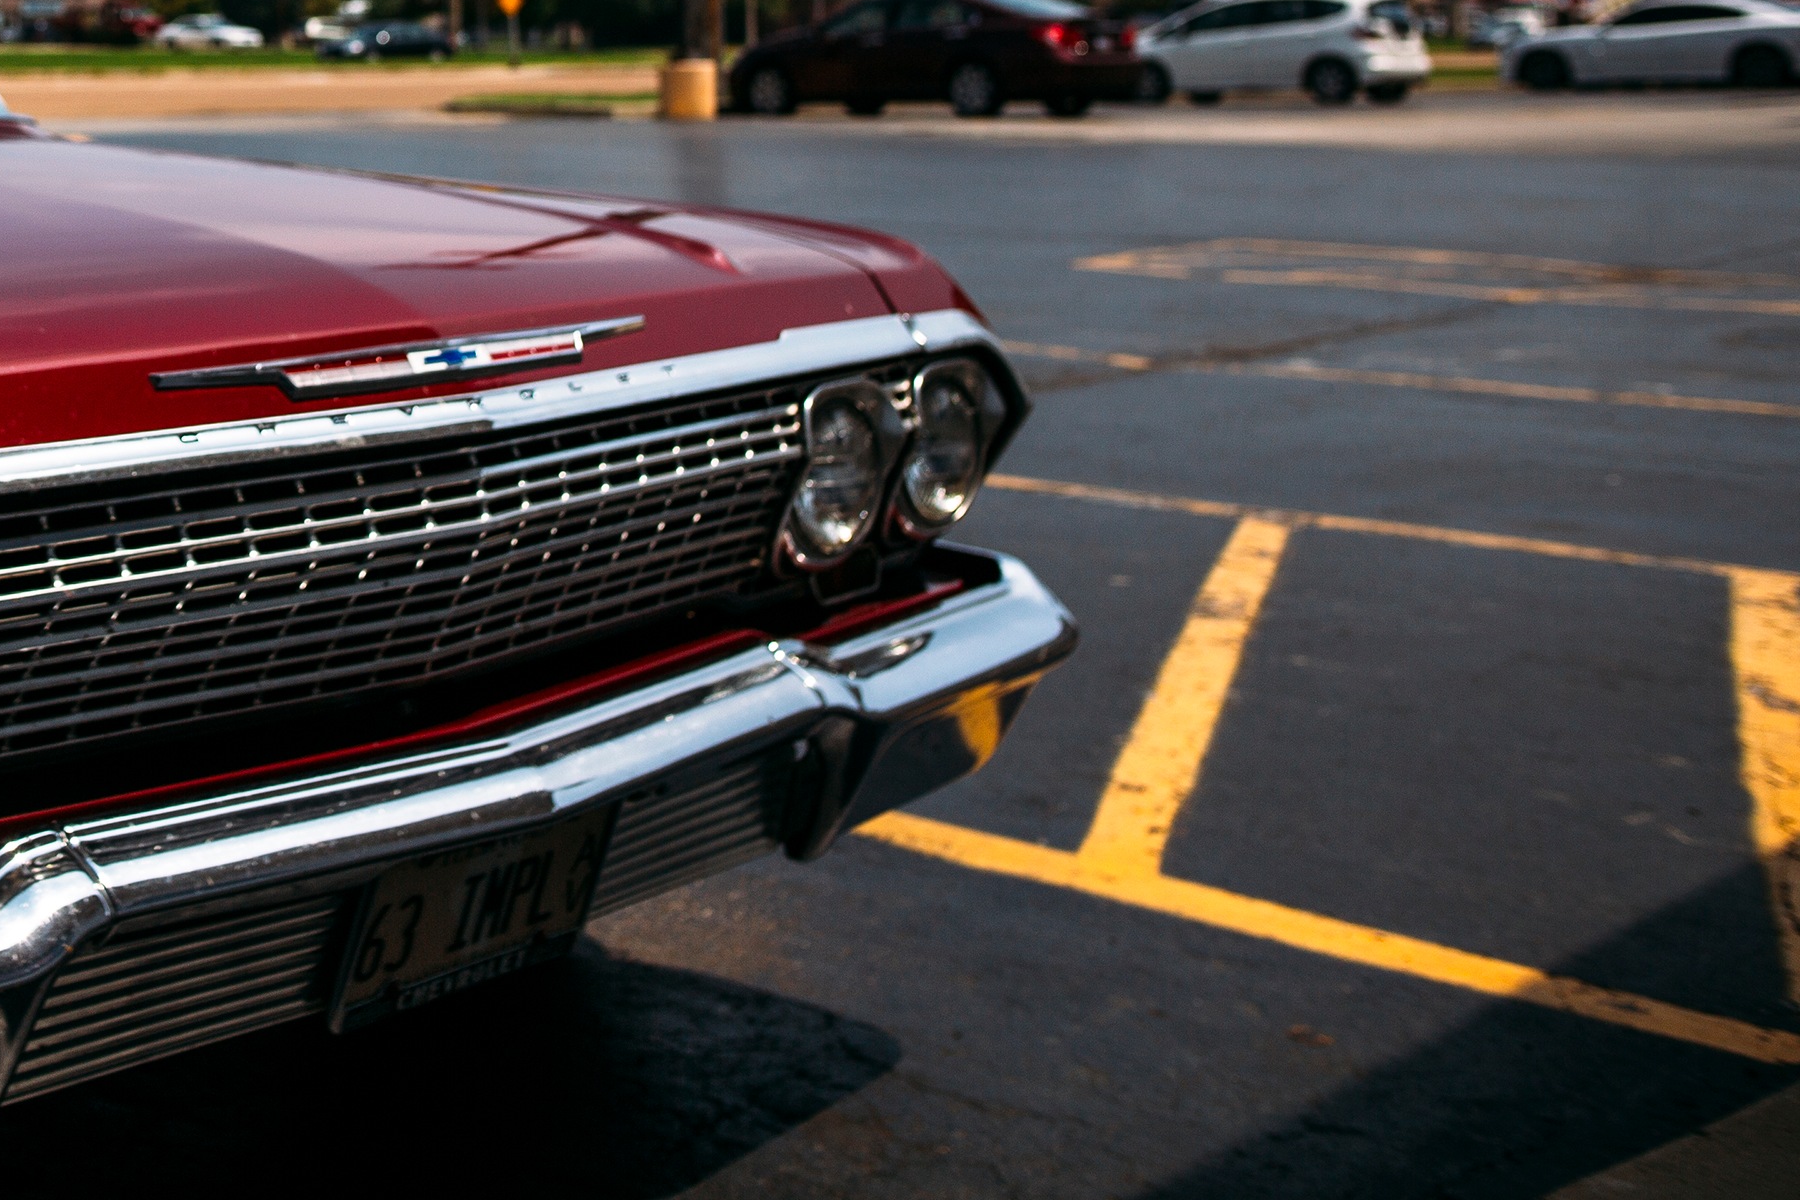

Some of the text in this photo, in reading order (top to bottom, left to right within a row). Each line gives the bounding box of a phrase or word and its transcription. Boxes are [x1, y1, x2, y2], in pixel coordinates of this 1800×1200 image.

[354, 850, 554, 982] 63 IMPL
[394, 950, 527, 1010] CHEVROLET
